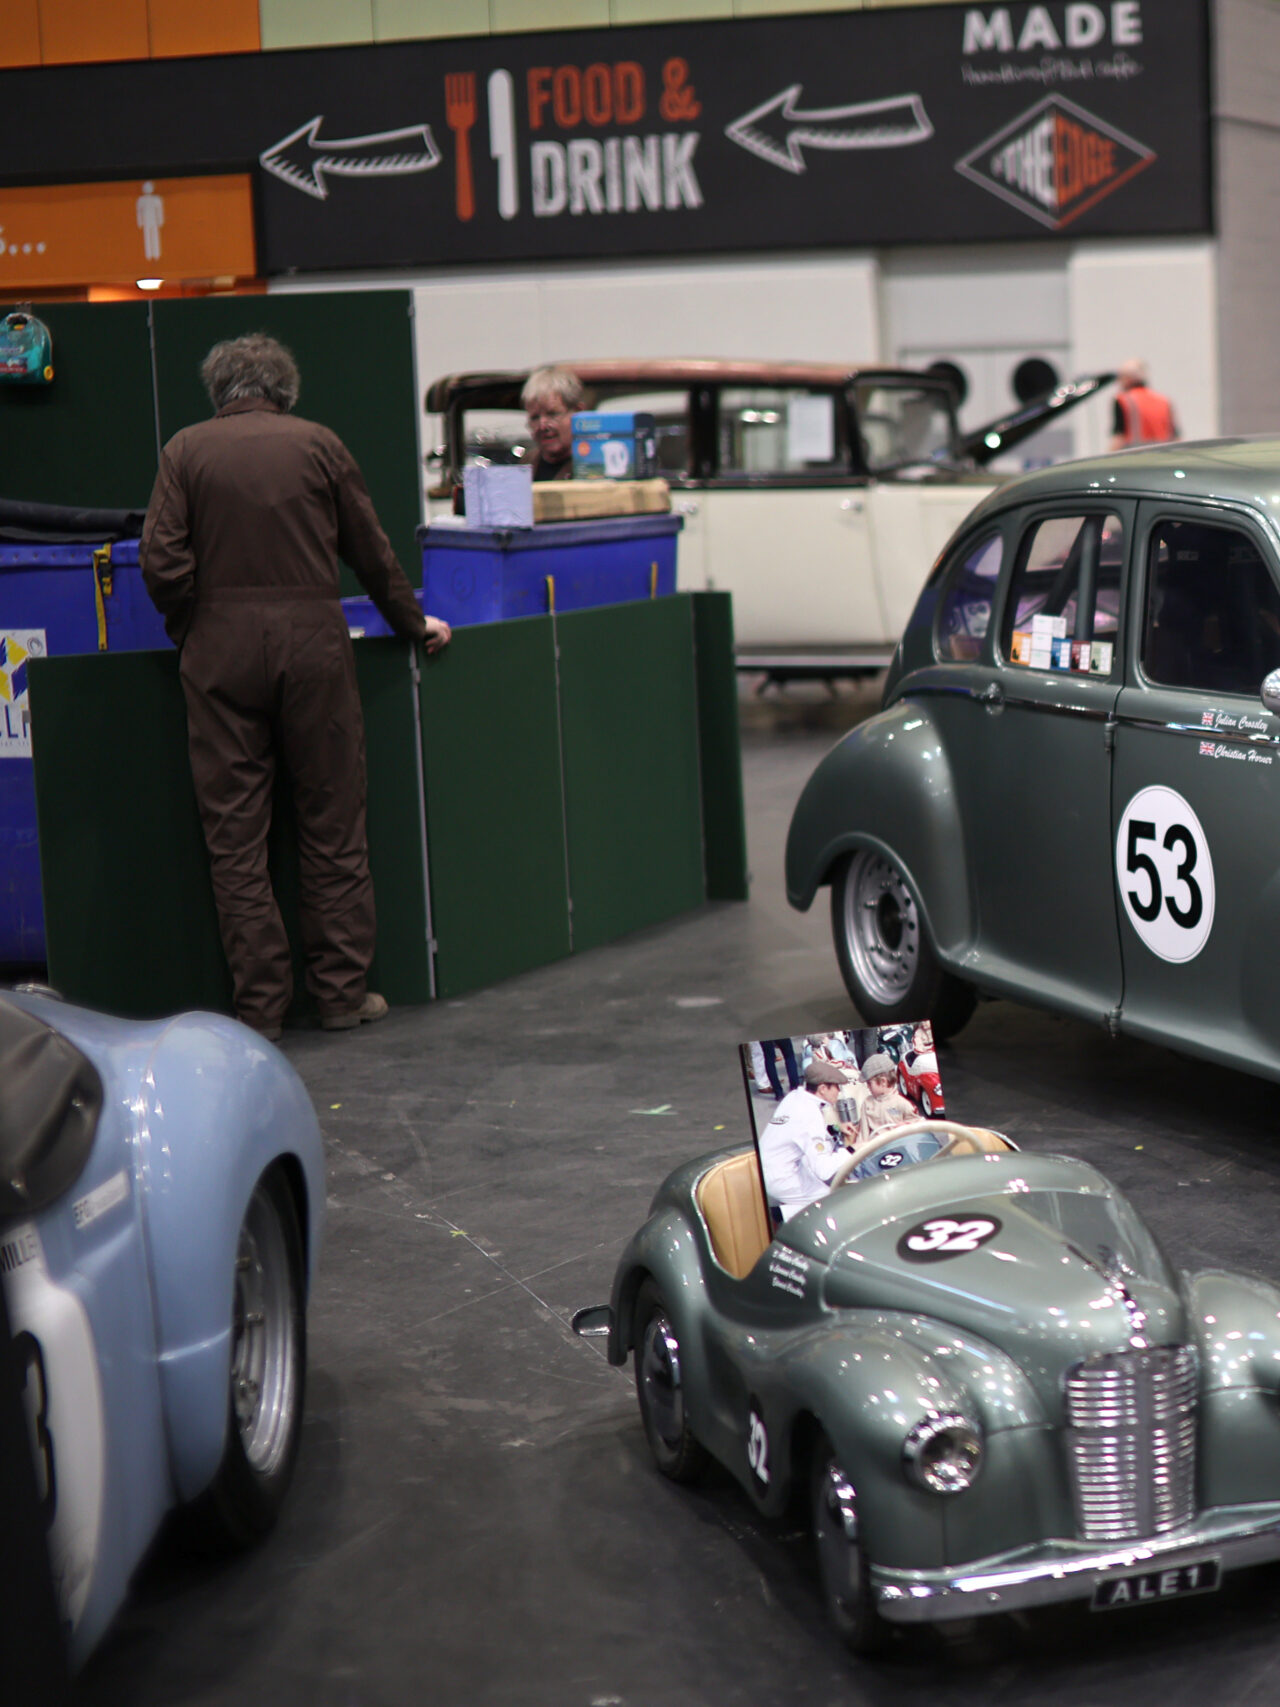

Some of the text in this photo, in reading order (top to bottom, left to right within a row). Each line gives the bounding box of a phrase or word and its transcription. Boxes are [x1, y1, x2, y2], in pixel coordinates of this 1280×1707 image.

[962, 0, 1143, 54] MADE
[526, 56, 703, 130] FOOD &
[530, 130, 704, 218] DRINK
[1214, 713, 1268, 733] Julian Crossley
[1214, 744, 1273, 765] Christian Horner
[1126, 818, 1204, 930] 53
[880, 1154, 903, 1167] 32
[907, 1219, 996, 1252] 32
[747, 1410, 770, 1485] 32
